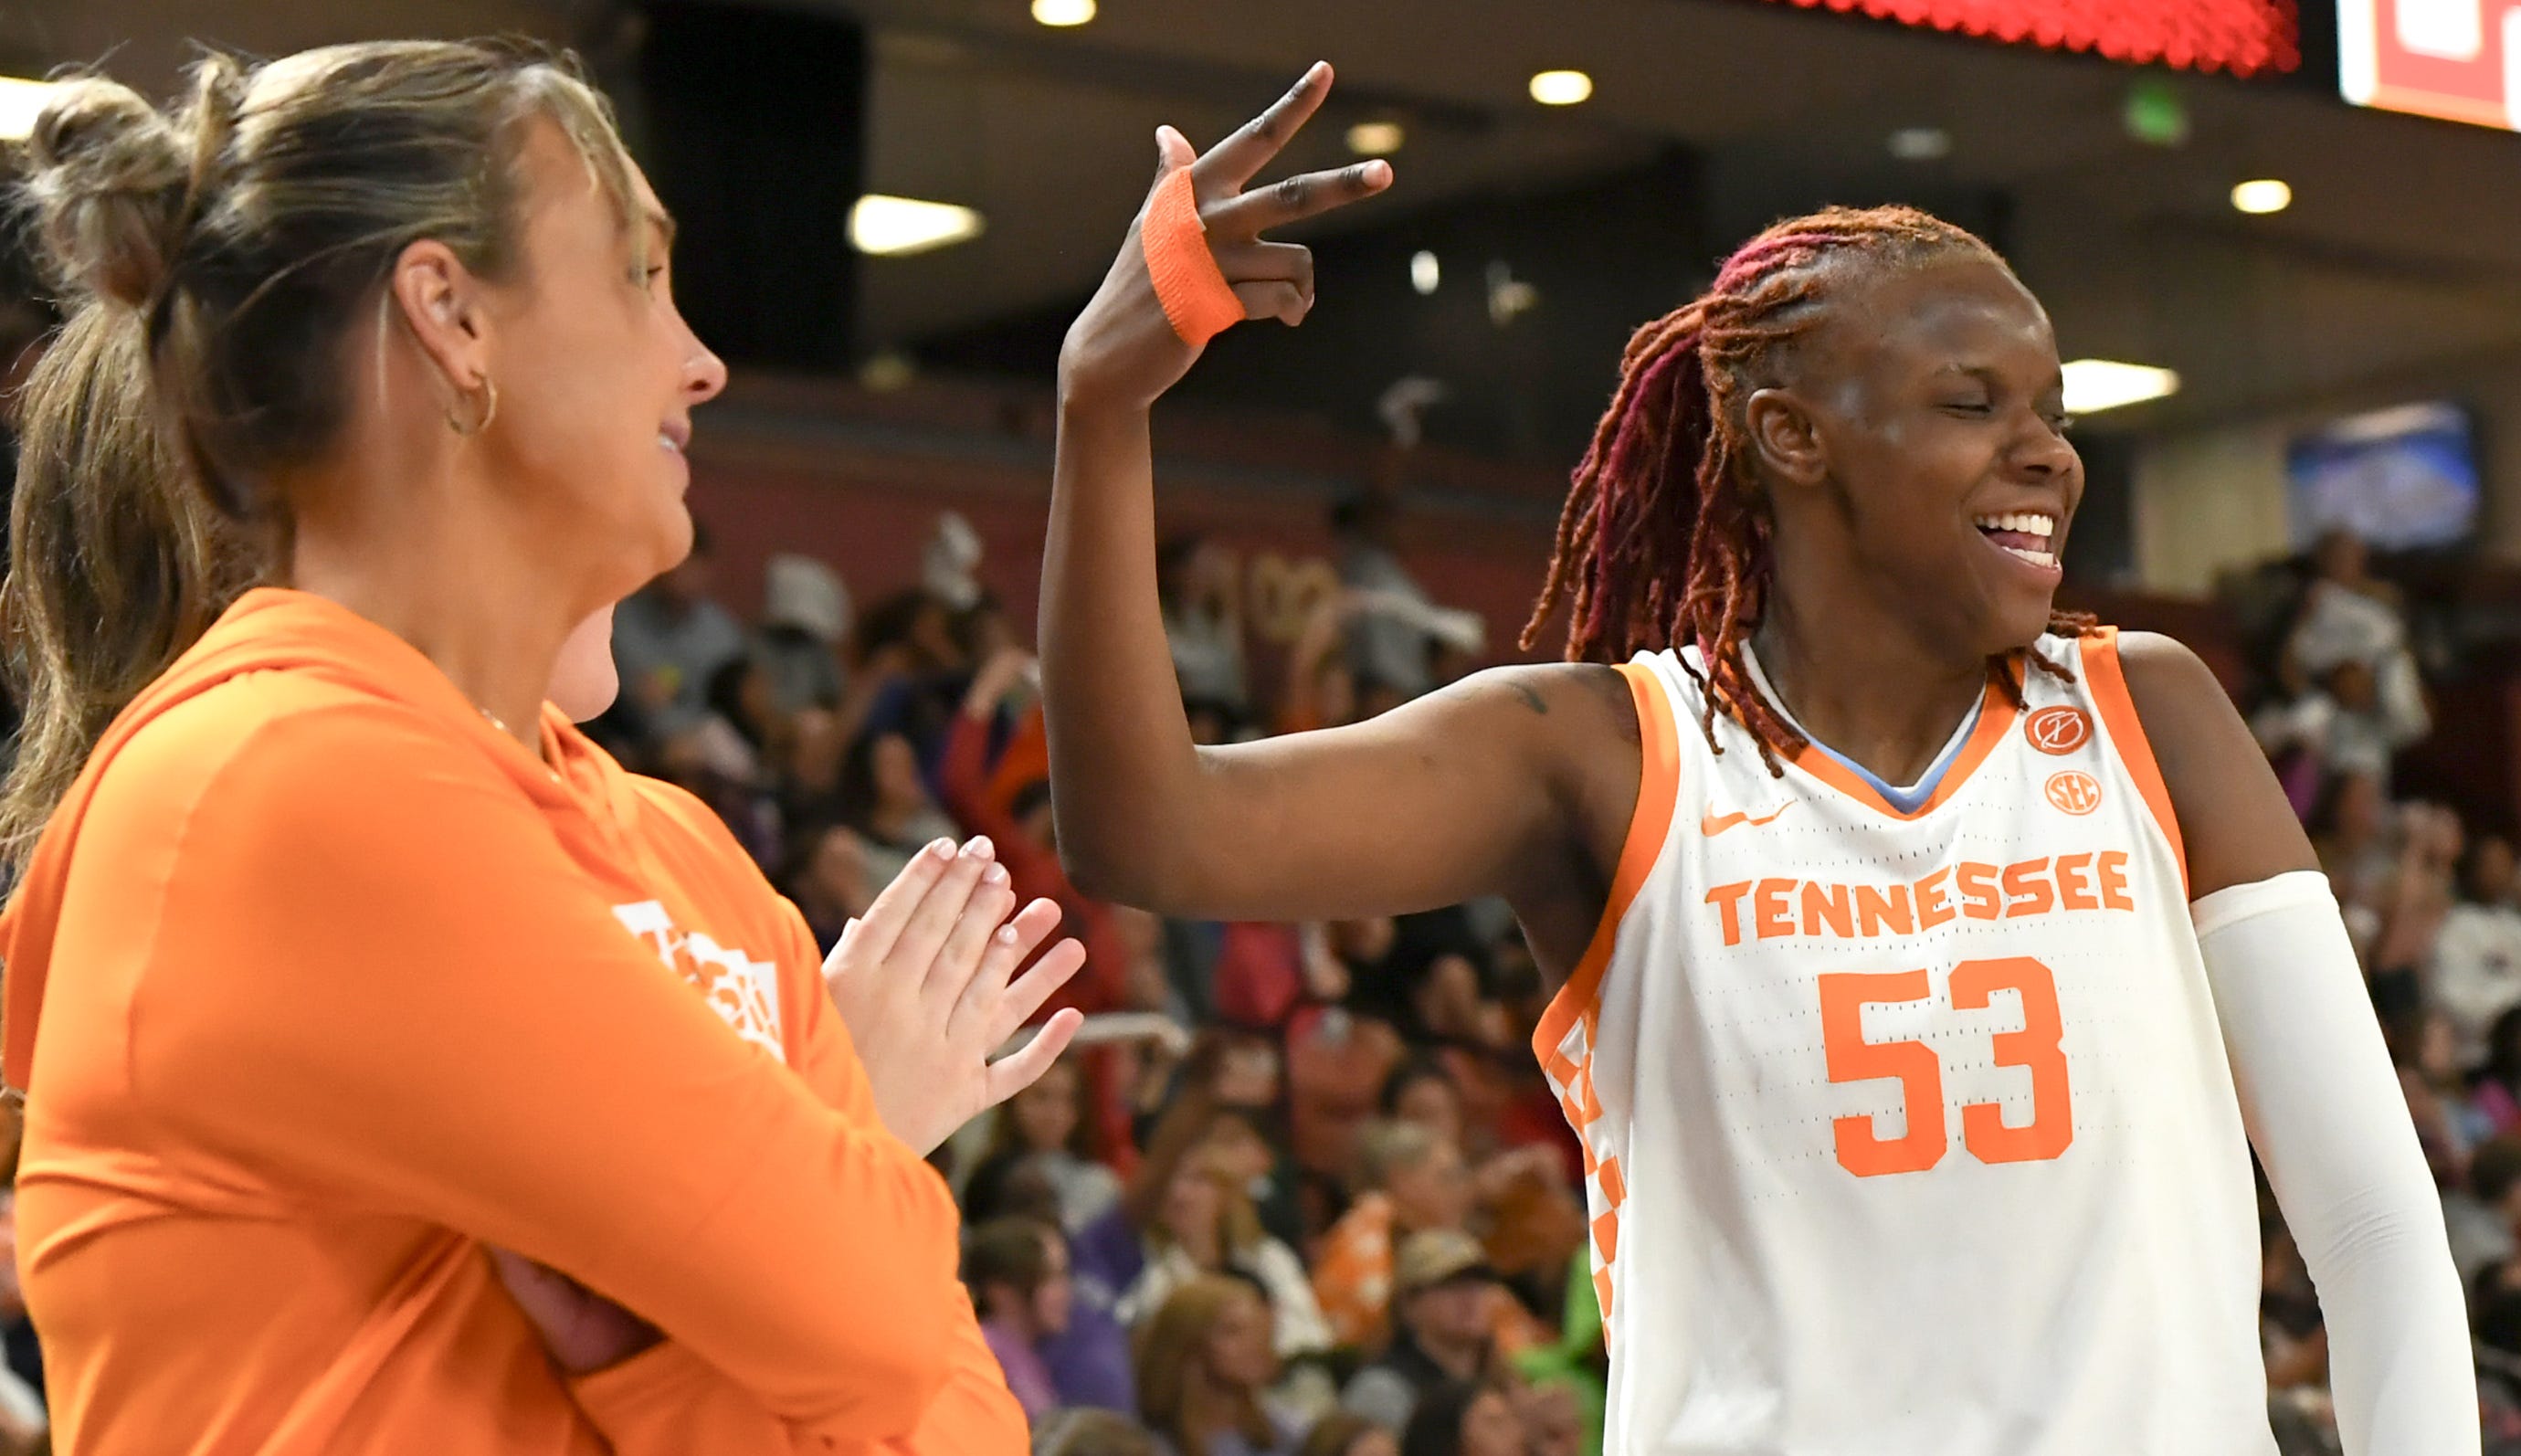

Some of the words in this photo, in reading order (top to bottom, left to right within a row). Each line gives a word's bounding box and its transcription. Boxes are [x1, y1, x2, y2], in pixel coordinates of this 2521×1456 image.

[2050, 774, 2097, 811] SEC
[1704, 850, 2135, 947] TENNESSEE
[1817, 955, 2074, 1177] 53
